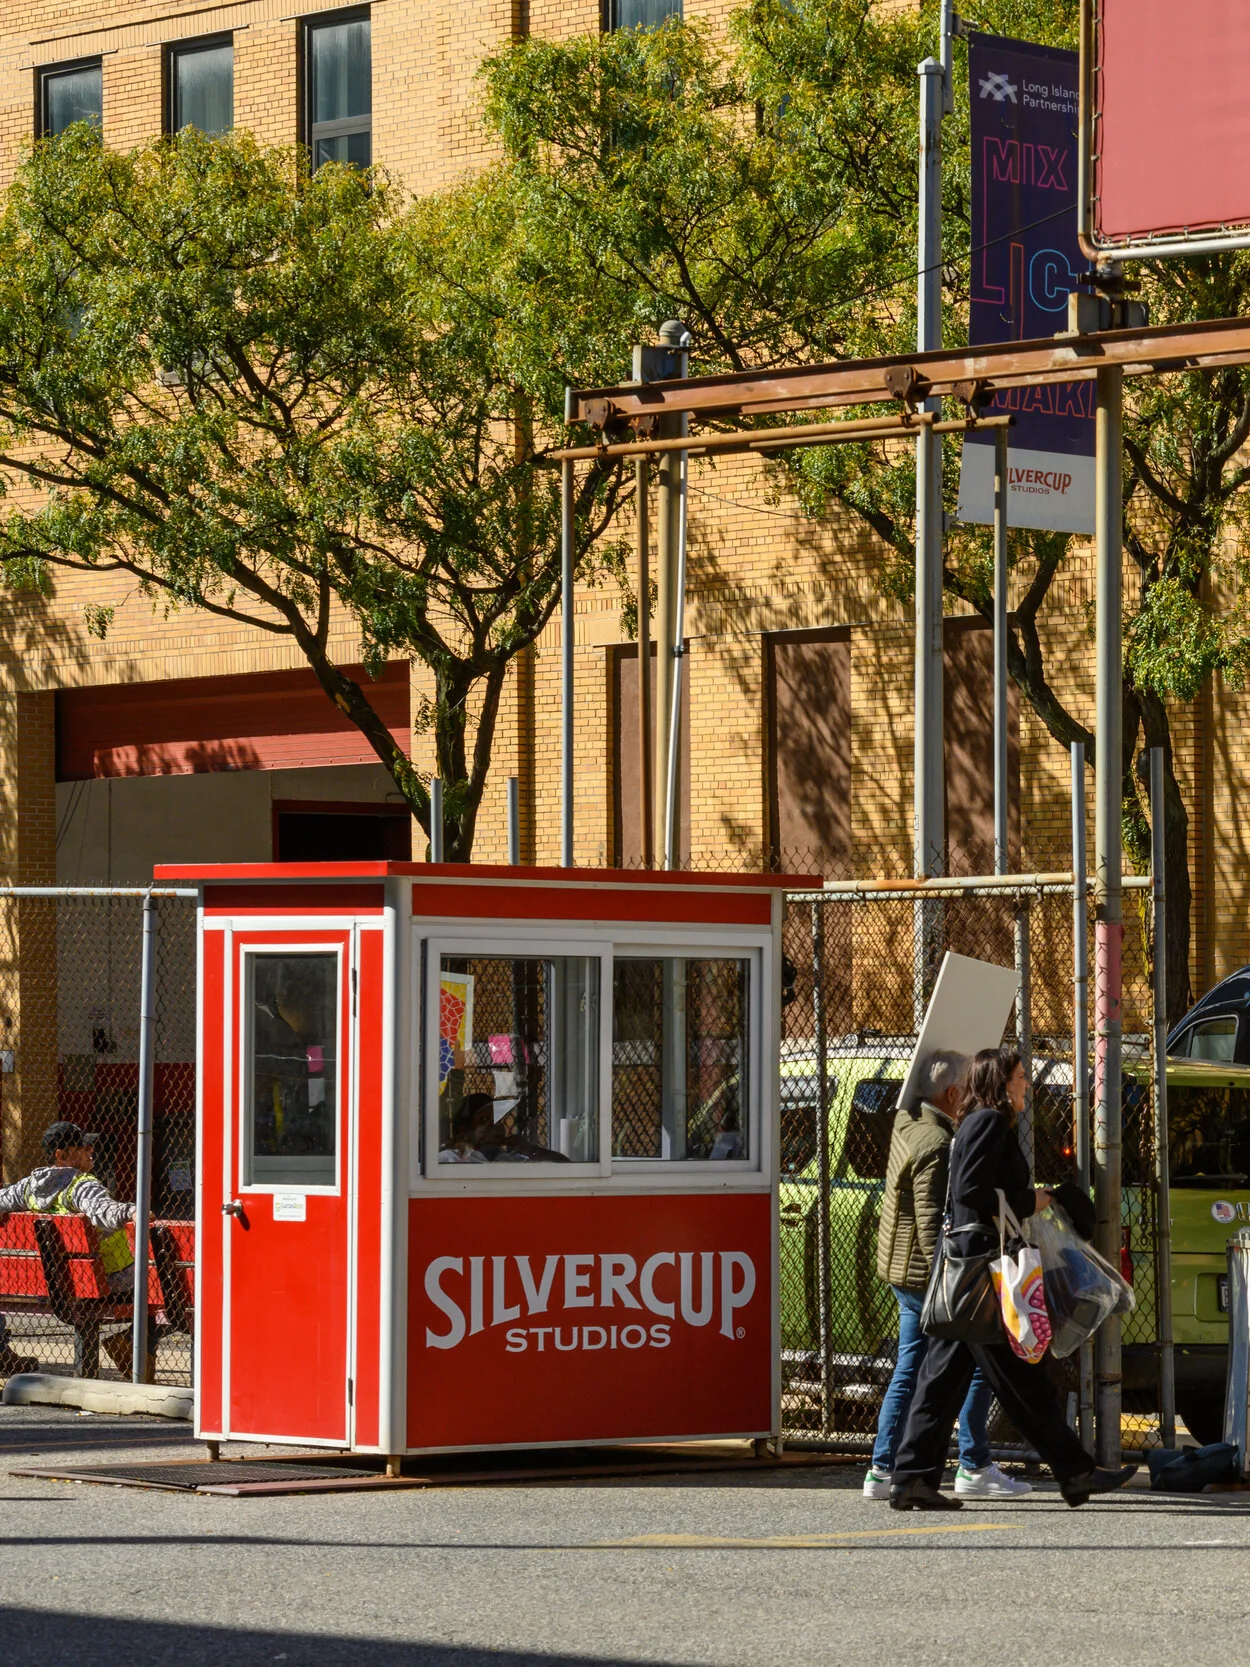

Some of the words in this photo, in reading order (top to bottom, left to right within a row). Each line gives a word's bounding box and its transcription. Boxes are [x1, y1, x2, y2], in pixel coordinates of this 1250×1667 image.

[1022, 79, 1048, 97] Long
[1022, 94, 1080, 115] Partnershi
[983, 136, 1069, 192] MIX
[1010, 484, 1051, 495] STUDIOS
[424, 1251, 757, 1350] SILVERCUP
[506, 1325, 672, 1353] STUDIOS
